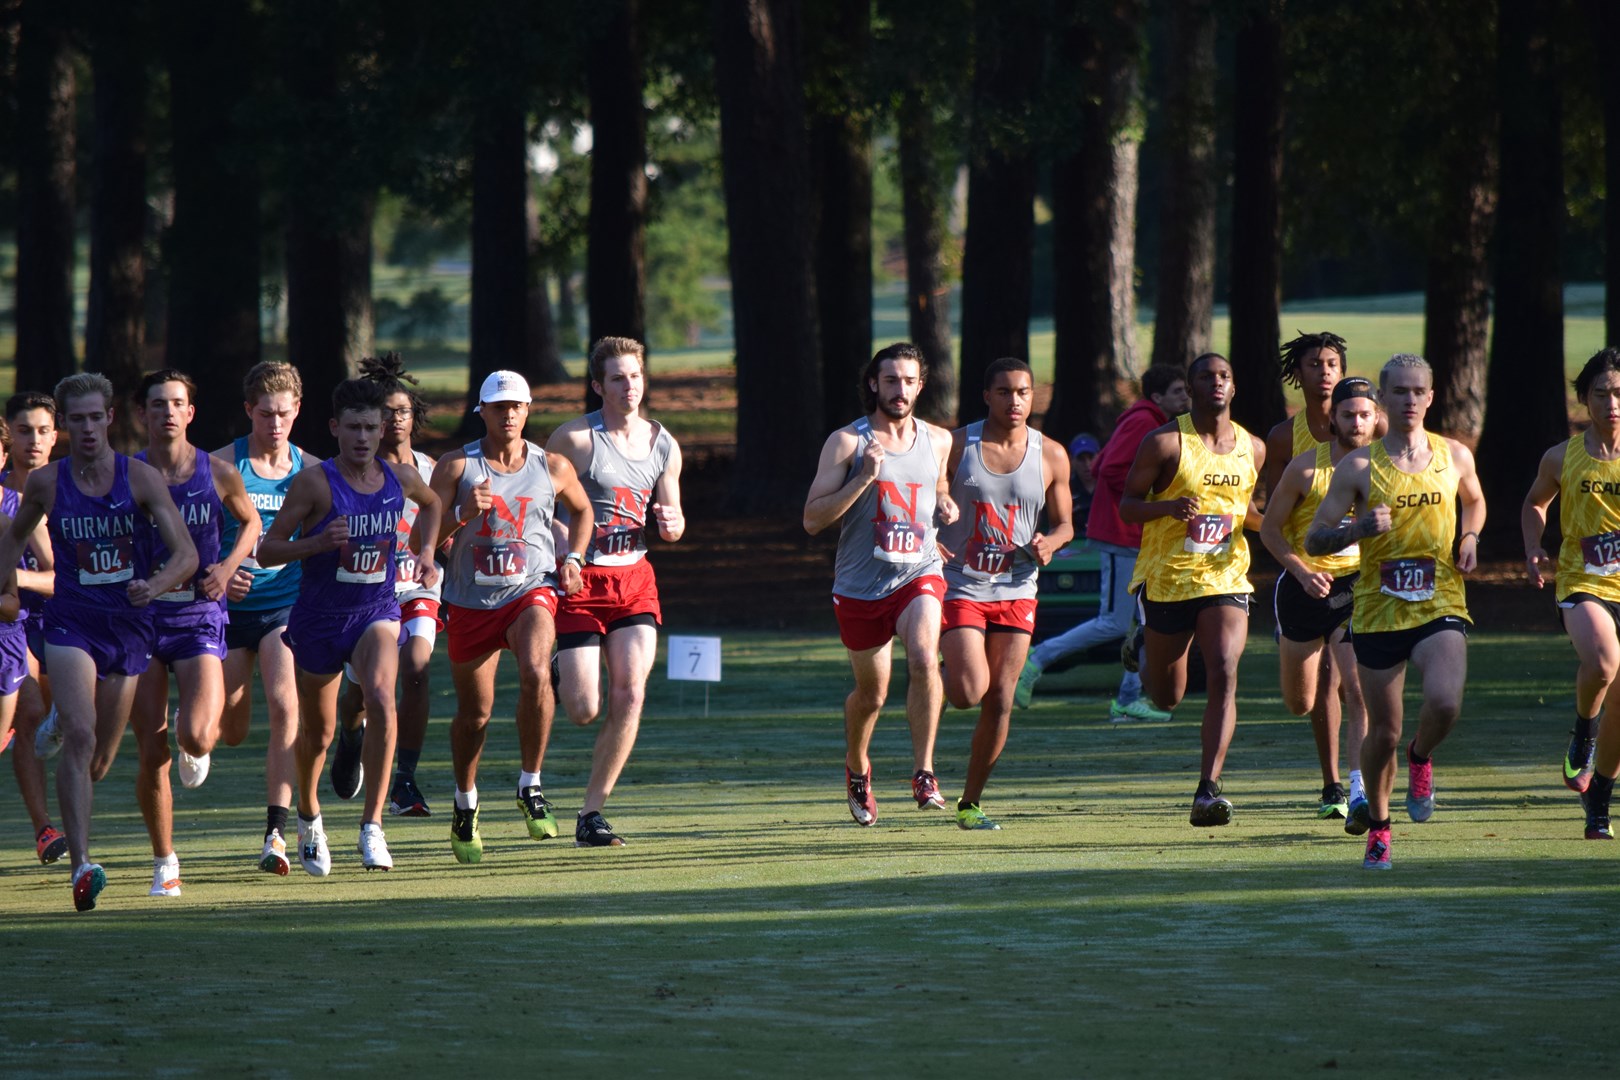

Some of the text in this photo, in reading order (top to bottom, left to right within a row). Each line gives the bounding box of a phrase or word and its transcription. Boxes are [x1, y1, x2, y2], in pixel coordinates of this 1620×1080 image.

[1202, 473, 1241, 487] SCAD
[1395, 491, 1442, 509] SCAD
[61, 513, 134, 539] FURMAN
[348, 510, 402, 537] URMAN
[1199, 522, 1225, 542] 124
[607, 534, 632, 554] 115
[886, 531, 915, 551] 118
[89, 550, 122, 572] 104
[352, 551, 381, 571] 107
[398, 559, 415, 580] 19
[486, 553, 517, 574] 114
[977, 552, 1005, 572] 117
[1393, 568, 1424, 590] 120
[689, 652, 701, 673] 7
